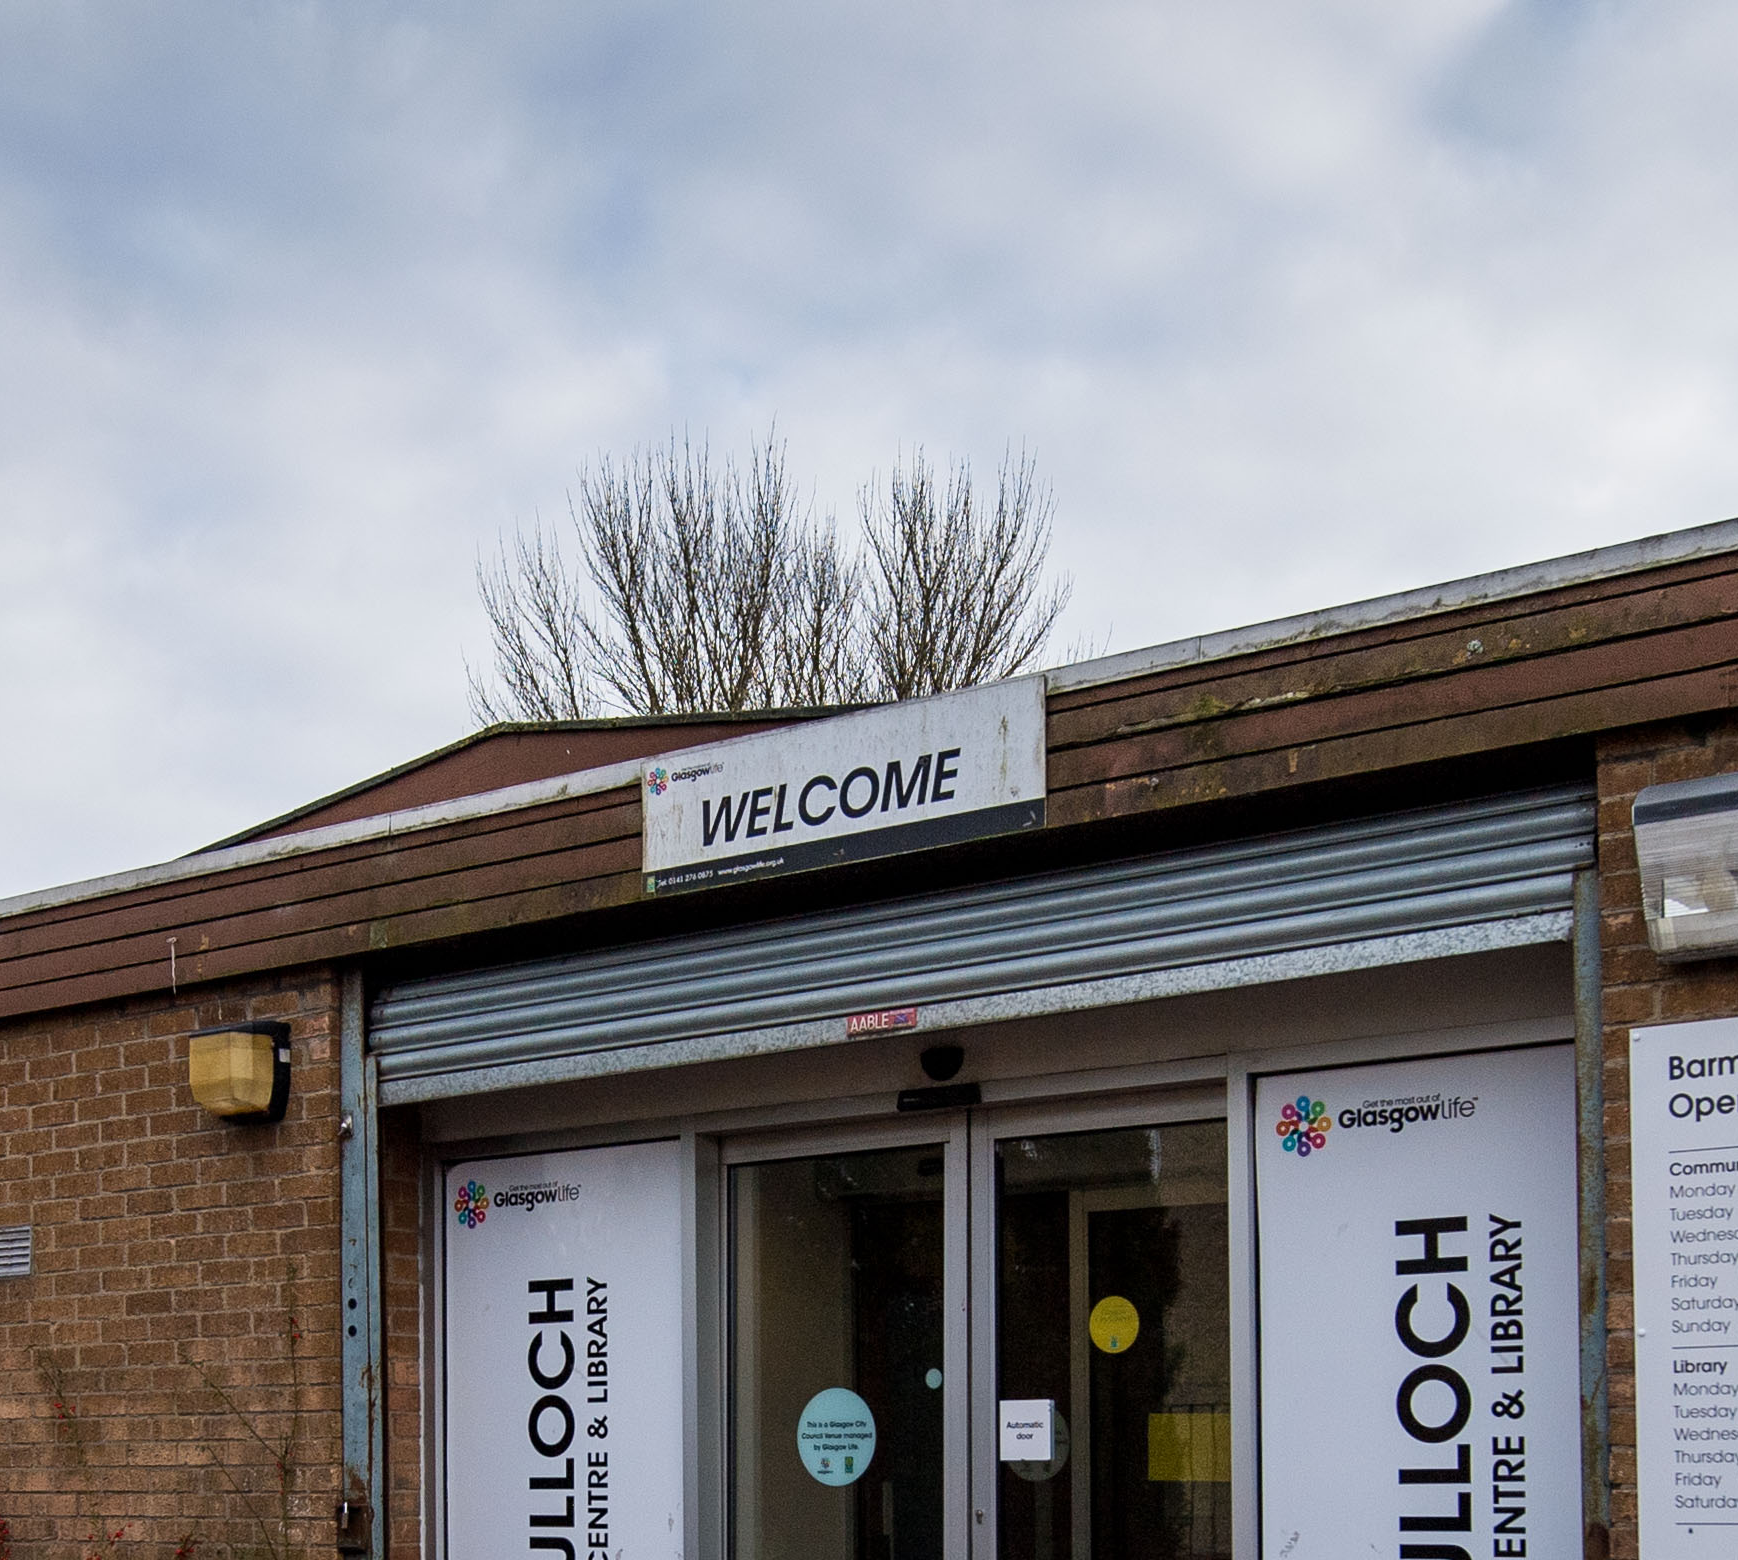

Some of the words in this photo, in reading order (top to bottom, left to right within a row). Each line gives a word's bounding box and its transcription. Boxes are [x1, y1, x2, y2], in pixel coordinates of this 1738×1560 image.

[702, 747, 962, 847] WELCOME
[851, 1013, 889, 1032] AABLE
[1669, 1183, 1736, 1199] Monday
[1669, 1206, 1734, 1222] Tuesday
[1670, 1275, 1718, 1290] Friday
[1488, 1213, 1525, 1374] LIBRARY
[1671, 1319, 1731, 1335] Sunday
[586, 1276, 608, 1403] LIBRARY
[1673, 1360, 1728, 1375] Library
[1491, 1389, 1526, 1419] &
[1673, 1405, 1738, 1420] Tuesday
[587, 1415, 608, 1439] &
[1016, 1432, 1034, 1440] door
[1674, 1472, 1722, 1488] Friday
